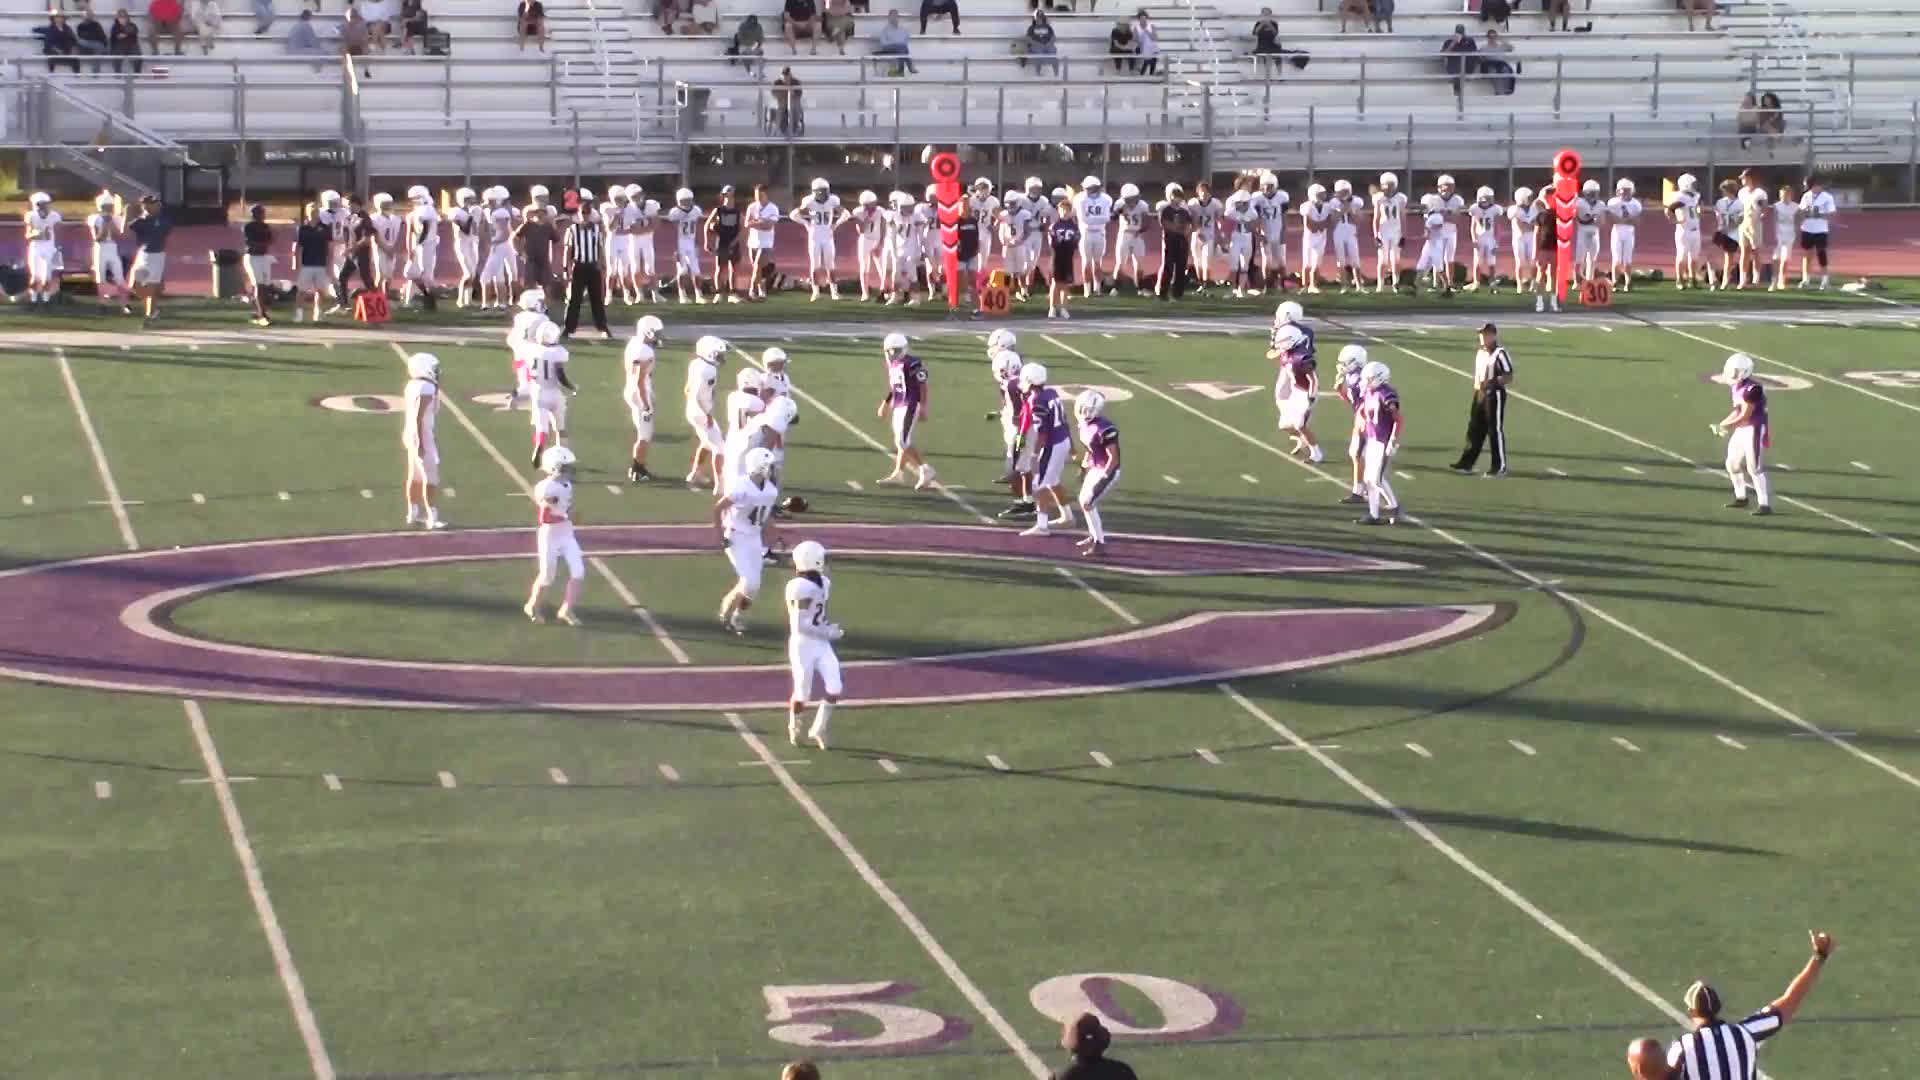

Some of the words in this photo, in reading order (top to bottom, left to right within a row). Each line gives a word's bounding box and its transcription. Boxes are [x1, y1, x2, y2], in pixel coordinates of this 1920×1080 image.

[983, 290, 1006, 310] 40
[1587, 282, 1608, 304] 30
[367, 295, 388, 319] 50
[763, 972, 1236, 1049] 50
